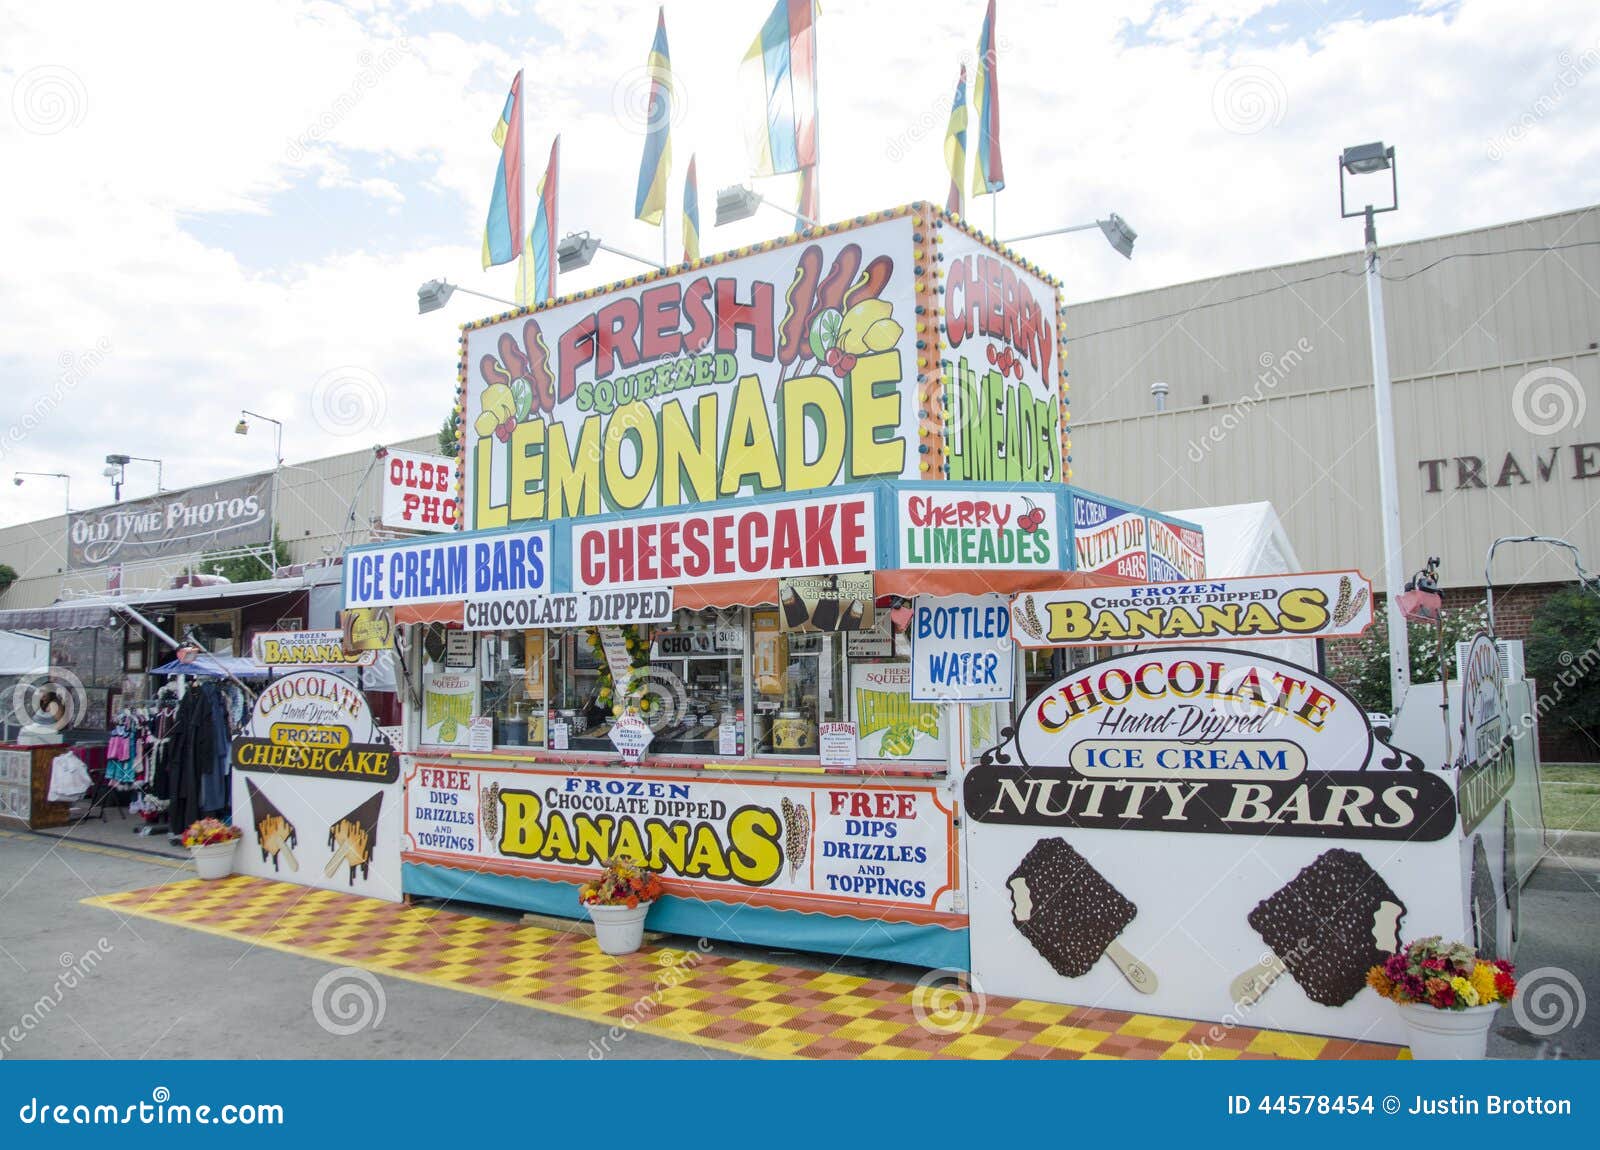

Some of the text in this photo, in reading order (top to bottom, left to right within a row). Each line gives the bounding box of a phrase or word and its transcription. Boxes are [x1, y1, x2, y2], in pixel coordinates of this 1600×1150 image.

[945, 255, 1053, 389] CHERRY
[558, 277, 775, 404] FRESH
[575, 353, 738, 414] SQUEEZED
[945, 355, 1060, 482] LIMEADES
[473, 349, 905, 530] LEMONADE
[390, 458, 449, 492] OLDE
[72, 519, 109, 544] OLD
[166, 495, 260, 530] PHOTOS
[1073, 498, 1107, 526] ICE CREAM
[580, 501, 867, 586] CHEESECAKE
[907, 527, 1050, 564] LIMEADES
[1076, 518, 1144, 569] NUTTY DIP
[351, 535, 544, 601] ICE CREAM BARS
[1118, 555, 1146, 579] BARS
[803, 588, 873, 600] Cheesecake
[1091, 588, 1278, 609] CHOCOLATE DIPPED
[1130, 583, 1226, 598] FROZEN
[466, 590, 670, 627] CHOCOLATE DIPPED
[918, 605, 1010, 641] BOTTLED
[1046, 588, 1330, 642] BANANAS
[280, 637, 319, 645] CHOCOLATE
[929, 651, 998, 686] WATER
[260, 677, 363, 719] CHOCOLATE
[1036, 660, 1337, 734] CHOCOLATE
[276, 728, 342, 745] FROZEN
[1097, 704, 1273, 745] Hand-Dipped
[237, 743, 389, 776] CHEESECAKE
[1084, 748, 1288, 771] ICE CREAM
[420, 768, 471, 791] FREE
[565, 778, 689, 799] FROZEN
[430, 791, 458, 805] DIPS
[545, 787, 726, 820] CHOCOLATE DIPPED
[829, 791, 917, 819] FREE
[990, 777, 1419, 828] NUTTY BARS
[416, 807, 474, 825] DRIZZLES
[845, 819, 897, 838] DIPS
[418, 832, 474, 852] TOPPINGS
[499, 788, 784, 887] BANANAS
[823, 841, 926, 863] DRIZZLES
[827, 874, 926, 898] TOPPINGS
[858, 865, 885, 876] AND
